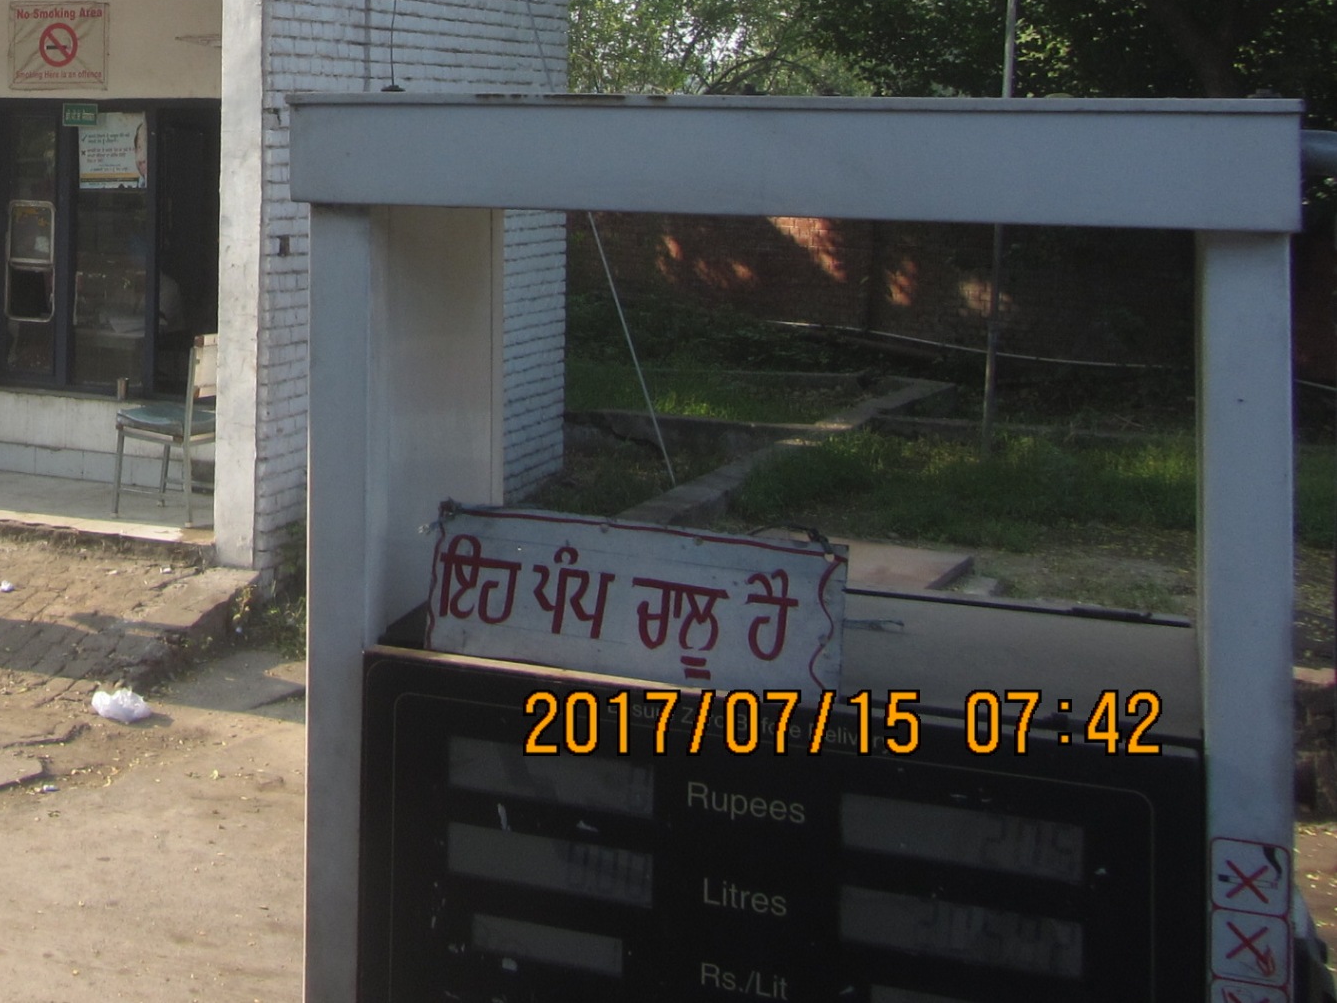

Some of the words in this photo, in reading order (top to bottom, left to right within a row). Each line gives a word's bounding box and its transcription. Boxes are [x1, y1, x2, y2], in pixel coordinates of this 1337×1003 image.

[17, 8, 30, 19] No
[33, 7, 76, 20] Smoking
[79, 7, 103, 18] Area
[439, 534, 522, 624] ਇਹ
[533, 546, 616, 639] ਪੰਪ
[632, 576, 730, 680] ਚਾਲੂ
[744, 569, 800, 661] ਹੈ
[687, 781, 806, 824] Rupees
[703, 878, 788, 917] Litres
[700, 962, 789, 1001] Rs./Lit
